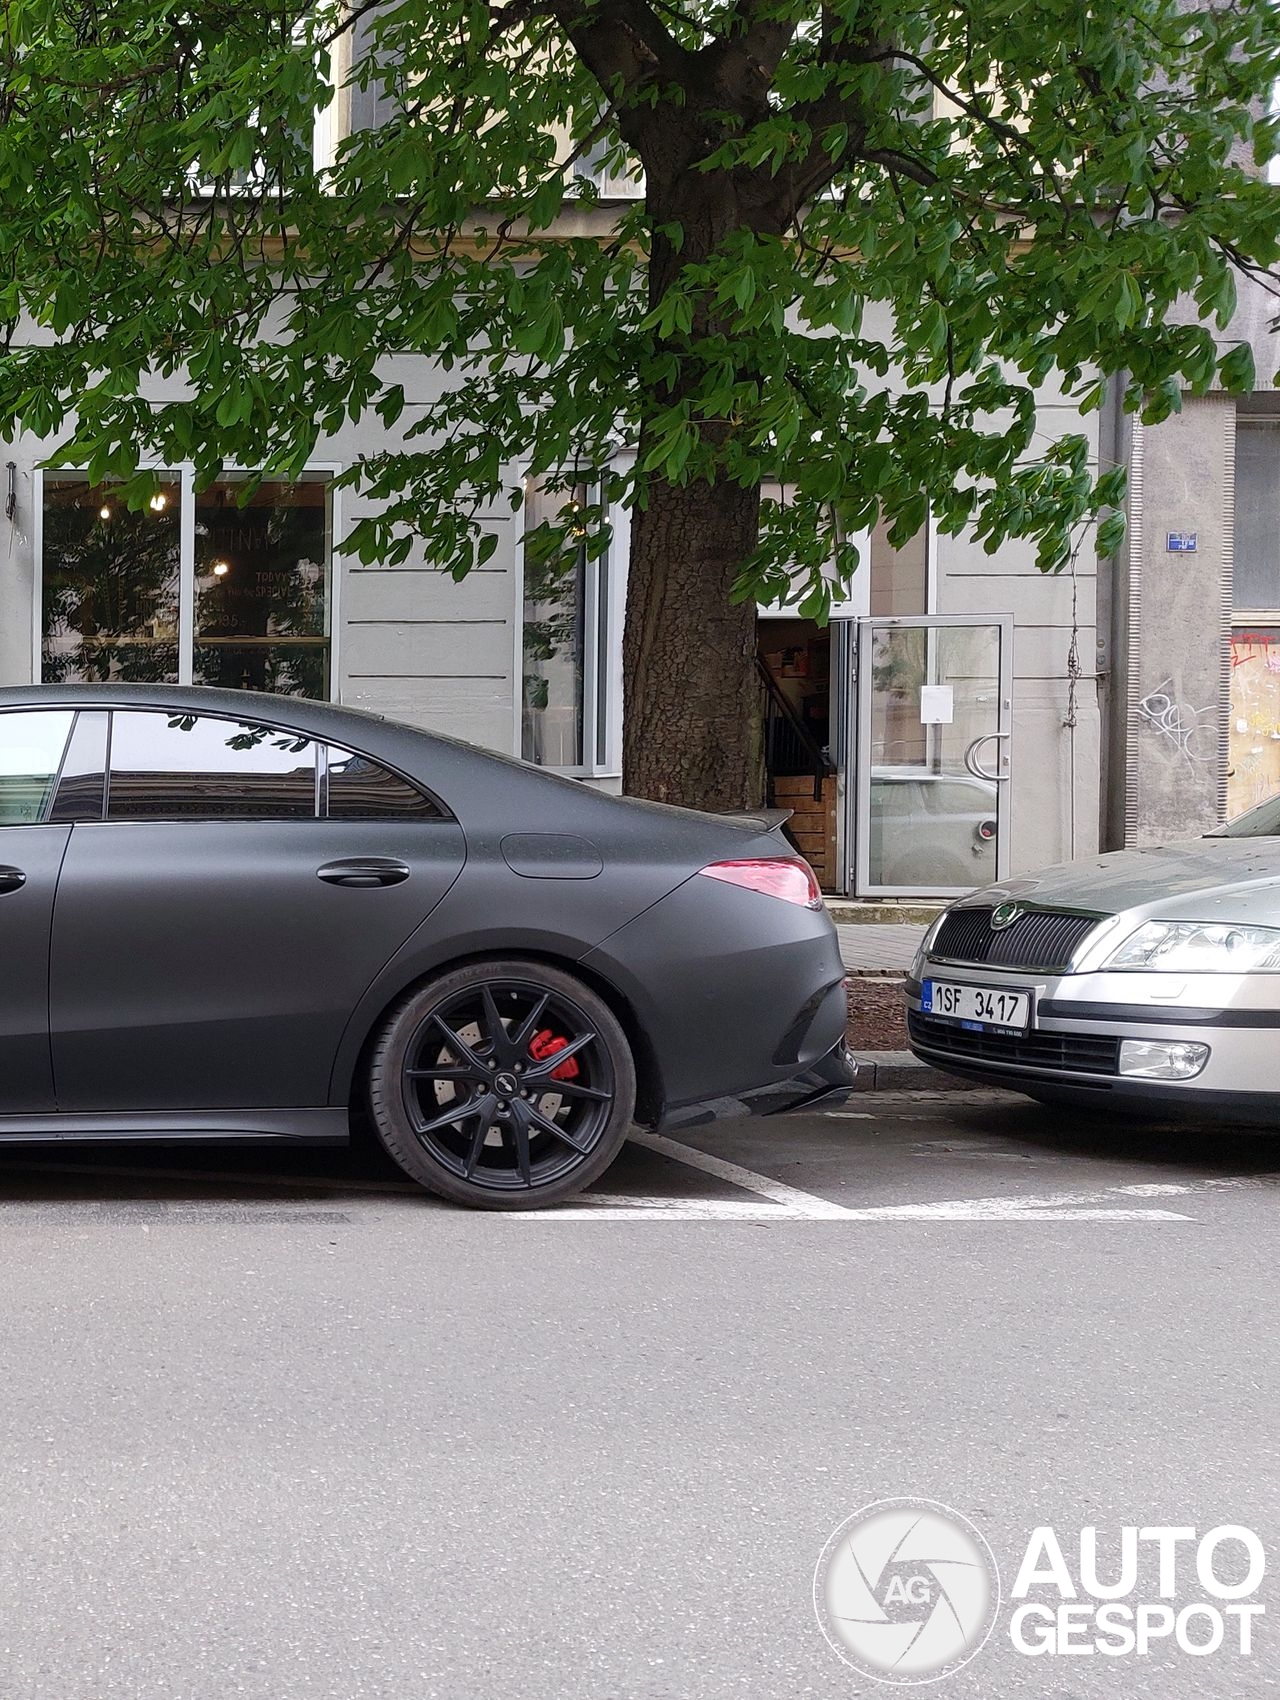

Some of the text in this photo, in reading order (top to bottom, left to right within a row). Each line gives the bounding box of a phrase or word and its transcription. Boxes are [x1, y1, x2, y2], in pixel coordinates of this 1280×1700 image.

[923, 1001, 932, 1010] CZ
[936, 986, 1019, 1022] 1SF 3417
